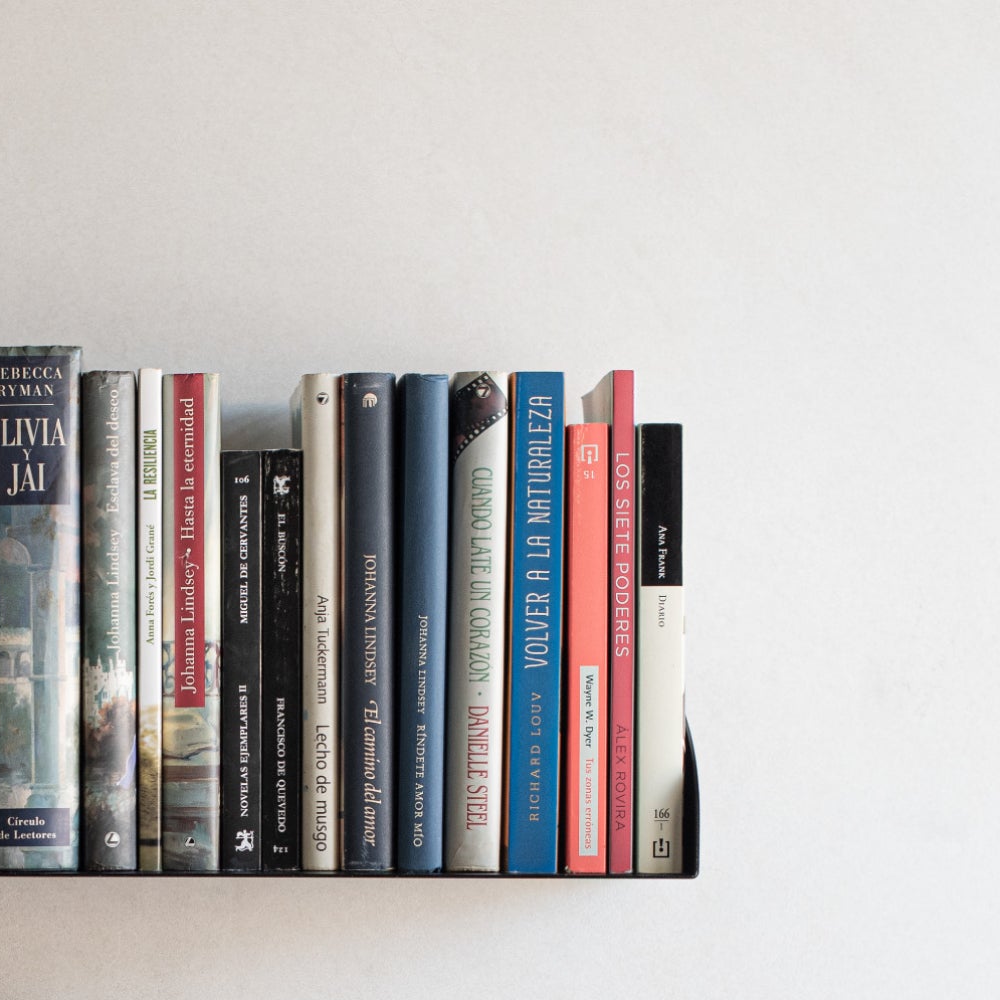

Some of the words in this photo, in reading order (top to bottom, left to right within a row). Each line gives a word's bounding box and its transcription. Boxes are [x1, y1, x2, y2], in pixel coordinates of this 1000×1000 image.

[22, 448, 32, 460] Y
[180, 397, 194, 472] eternidad
[234, 474, 250, 484] 106
[527, 395, 552, 523] NATURALEZA
[615, 452, 629, 490] LOS
[180, 478, 194, 490] la
[471, 467, 493, 530] CUANDO
[180, 495, 195, 540] Hasta
[239, 495, 248, 560] CERVANTES
[277, 513, 286, 527] EL
[615, 498, 629, 554] SIETE
[277, 531, 288, 572] BUSCÓN
[470, 537, 492, 574] LATE
[526, 535, 550, 559] LA
[180, 560, 199, 623] Lindsey
[239, 563, 248, 578] DE
[363, 554, 377, 623] JOHANNA
[470, 581, 492, 601] UN
[526, 570, 550, 581] A
[239, 581, 248, 624] MIGUEL
[314, 595, 330, 623] Anja
[615, 562, 629, 657] PODERES
[468, 607, 494, 683] CORAZÓN
[525, 592, 550, 669] VOLVER
[181, 628, 197, 694] Johanna
[317, 628, 329, 704] Tuckermann
[364, 626, 377, 686] LINDSEY
[238, 684, 247, 692] II
[239, 695, 250, 764] EJEMPLARES
[276, 697, 286, 757] FRANCISCO
[364, 700, 381, 724] El
[530, 691, 541, 736] LOUV
[315, 725, 331, 770] Lecho
[364, 726, 381, 779] camino
[467, 705, 489, 779] DANIELLE
[615, 724, 630, 764] ÁLEX
[277, 760, 286, 776] DE
[315, 776, 331, 794] de
[529, 745, 540, 821] RICHARD
[239, 766, 249, 817] NOVELAS
[276, 779, 286, 833] QUEVEDO
[364, 783, 381, 804] del
[466, 784, 488, 830] STEEL
[615, 771, 627, 831] ROVIRA
[654, 807, 670, 819] 166
[7, 816, 45, 826] Círculo
[14, 830, 57, 839] Lectores
[312, 800, 327, 852] musgo
[364, 806, 376, 847] amor
